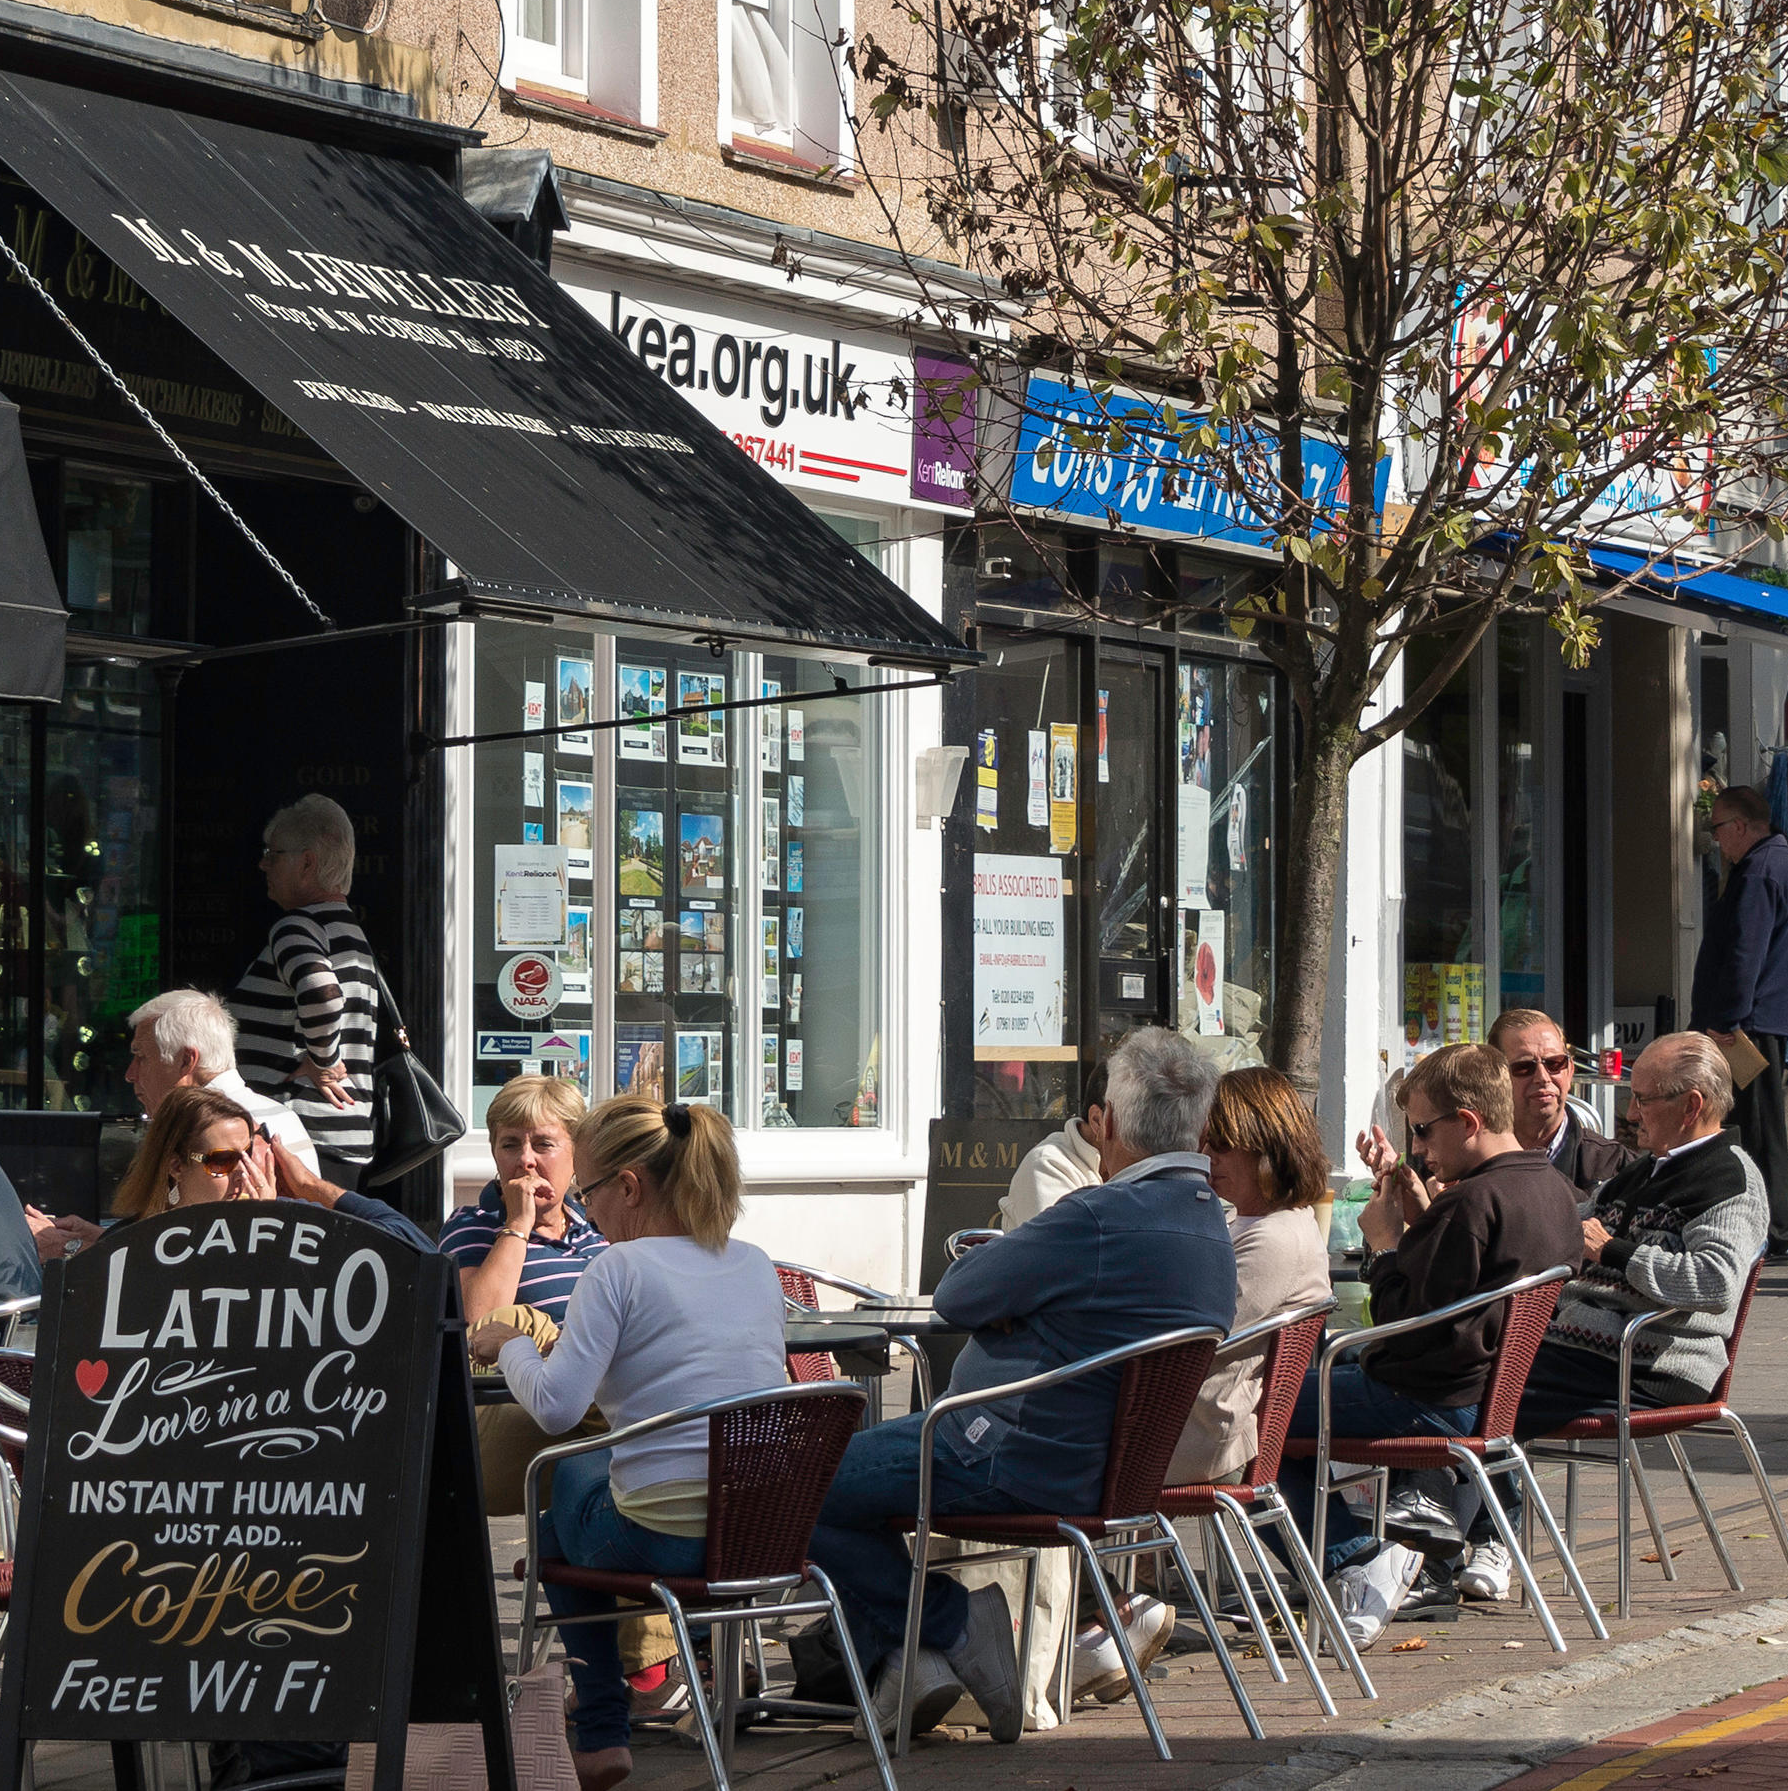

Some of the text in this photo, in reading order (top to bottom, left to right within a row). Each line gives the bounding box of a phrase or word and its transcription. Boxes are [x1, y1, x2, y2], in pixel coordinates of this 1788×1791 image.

[111, 213, 201, 268] M.
[181, 228, 244, 280] &
[288, 249, 551, 329] JEWELLERY
[611, 290, 857, 429] kea.org.uk
[293, 379, 695, 455] JEWELLERS WATCHMAKERS SILVERSMITHS
[916, 458, 975, 492] KentRelianc
[505, 869, 559, 879] KentReliance
[999, 874, 1058, 899] ASSOCIATES LTD
[993, 918, 1010, 936] YOUR
[1011, 919, 1037, 937] BUILDING
[1037, 920, 1055, 937] NEEDS
[513, 997, 549, 1006] NAEA
[940, 1141, 1019, 1169] M & M
[154, 1216, 328, 1268] CAFE
[99, 1245, 390, 1350] LATINO
[68, 1349, 388, 1463] Love in a Cup
[68, 1480, 367, 1517] INSTANT HUMAN
[154, 1522, 304, 1548] JUST ADD...
[62, 1539, 360, 1647] Coffee
[51, 1656, 332, 1715] FREE Wi Fi
